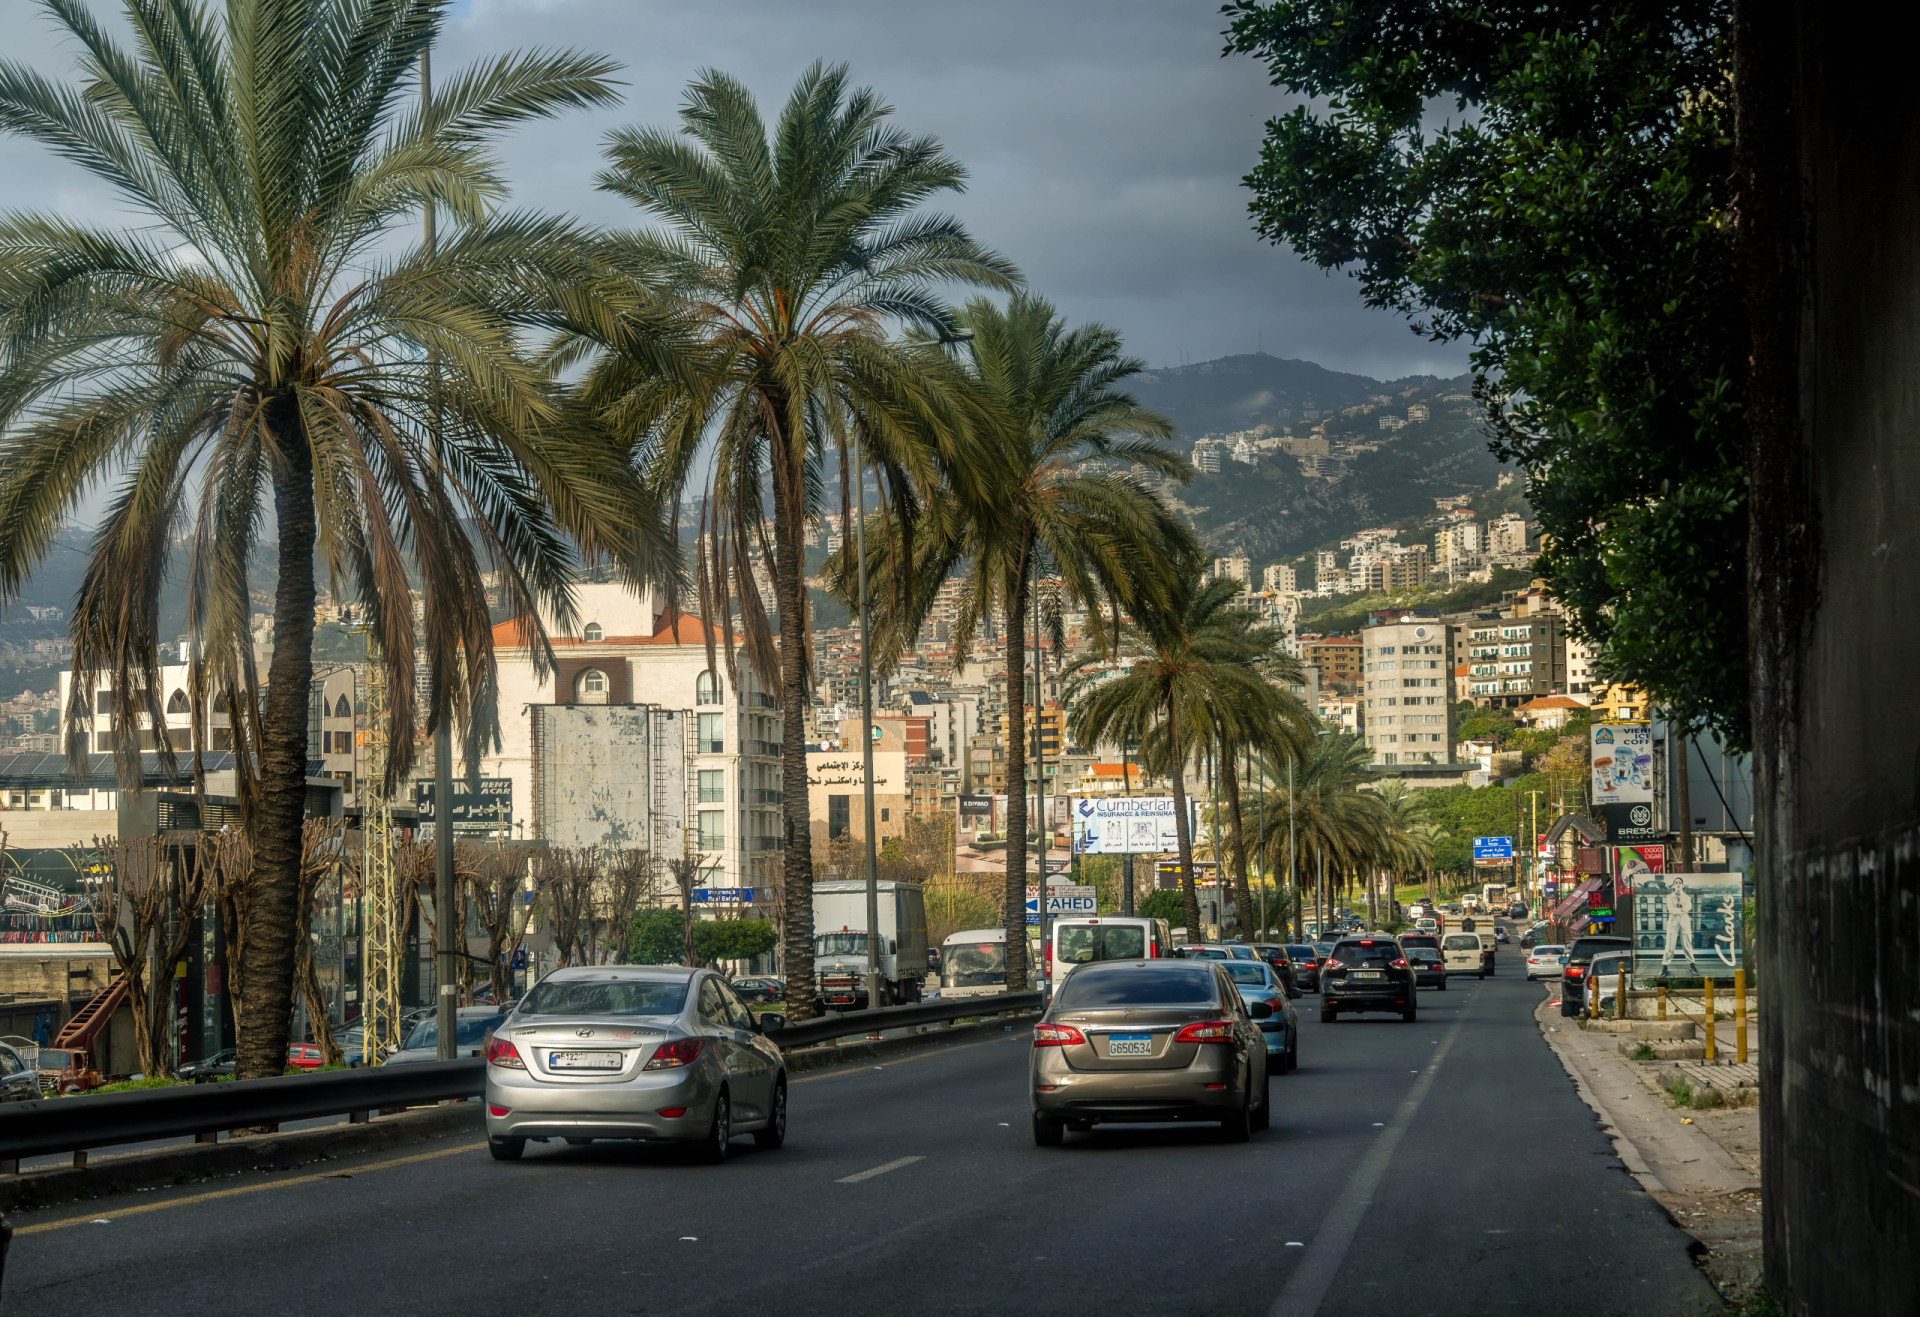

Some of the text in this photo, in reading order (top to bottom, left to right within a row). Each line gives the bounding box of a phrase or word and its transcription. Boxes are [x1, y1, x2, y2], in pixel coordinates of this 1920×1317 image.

[419, 781, 473, 795] TIN
[419, 800, 464, 817] سرات
[1096, 799, 1176, 812] Cumberlan
[1045, 898, 1094, 909] FAHED
[1714, 894, 1736, 967] Clarks
[1110, 1043, 1151, 1054] G650534
